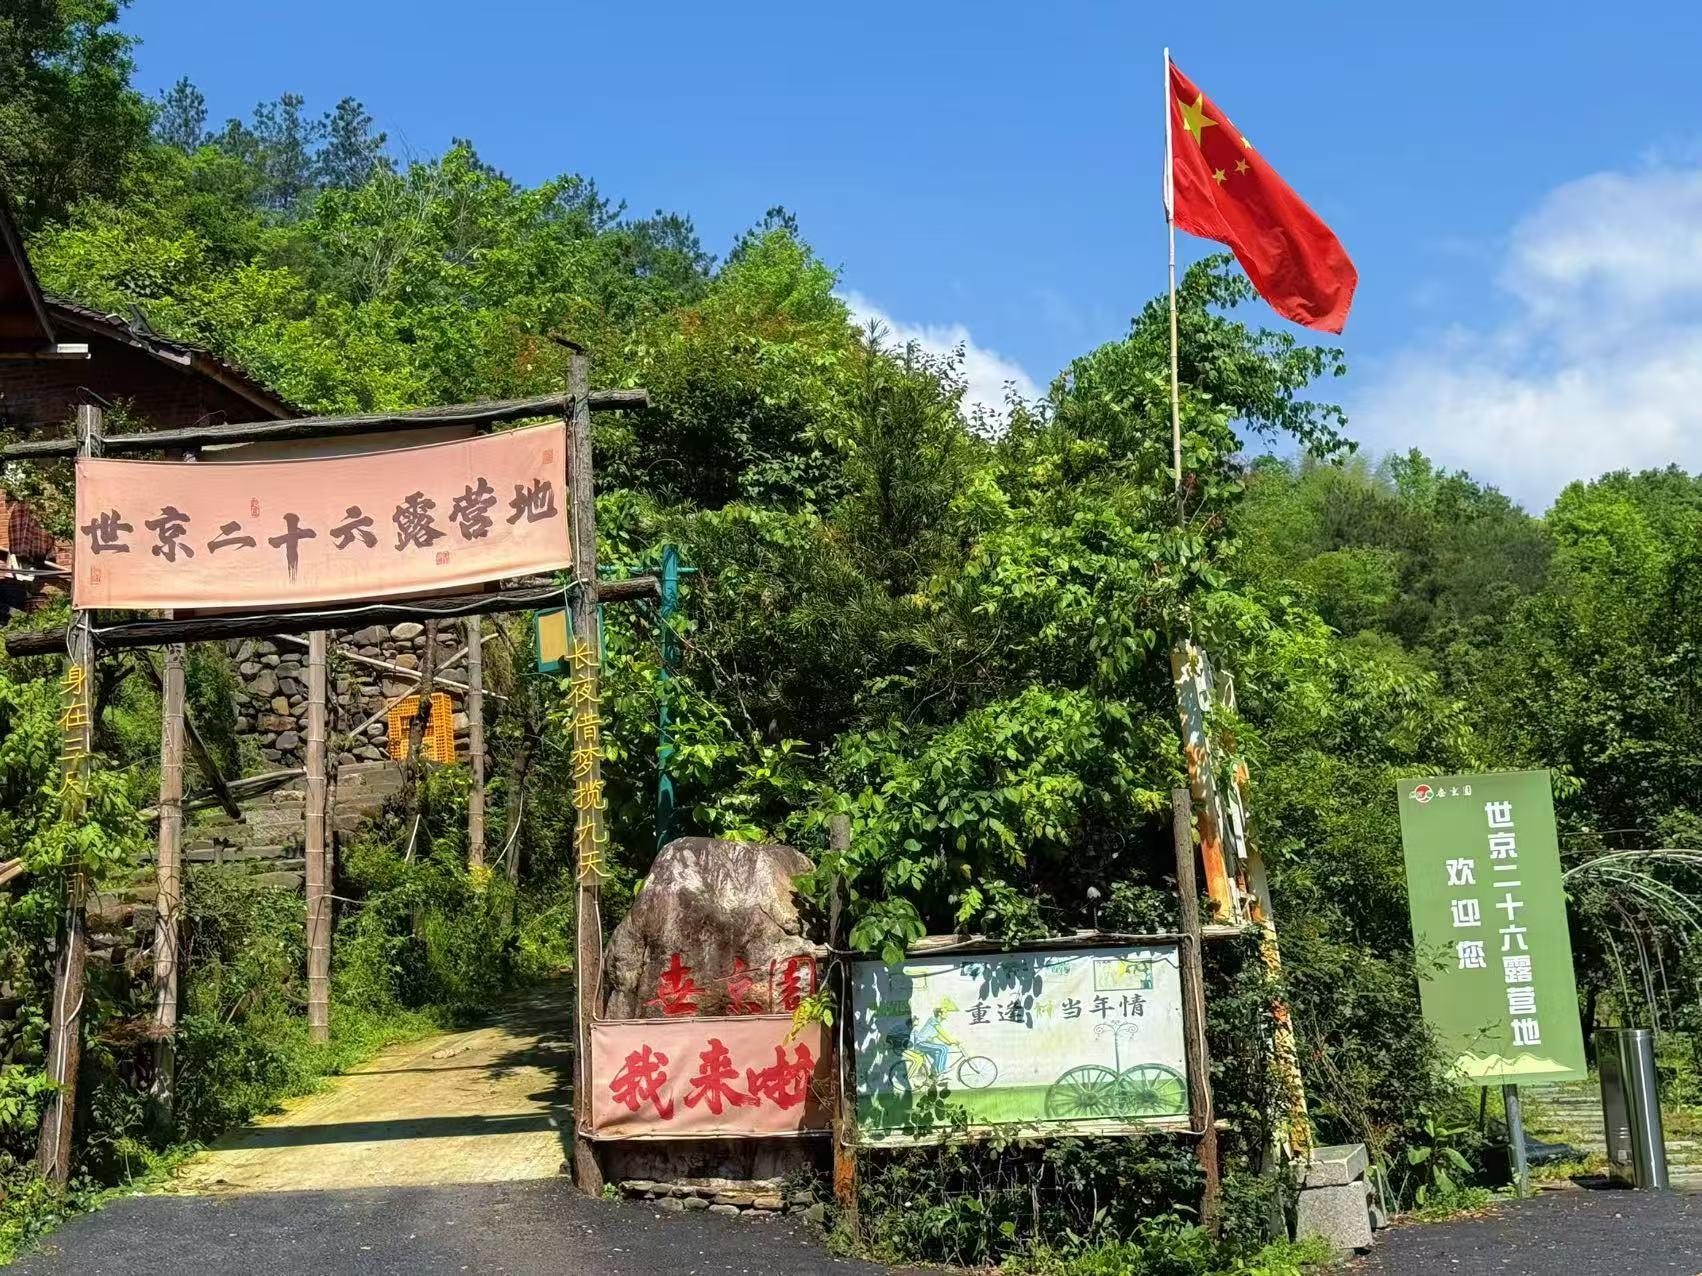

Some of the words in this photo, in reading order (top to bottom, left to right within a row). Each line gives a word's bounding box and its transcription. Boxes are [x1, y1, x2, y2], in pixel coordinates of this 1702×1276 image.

[81, 477, 559, 583] 世京二十六露营地
[566, 640, 610, 879] 长夜借梦揽九天
[1446, 857, 1487, 970] 欢迎您
[1485, 800, 1541, 1046] 世京二十六露营地
[1061, 993, 1147, 1020] 当年情
